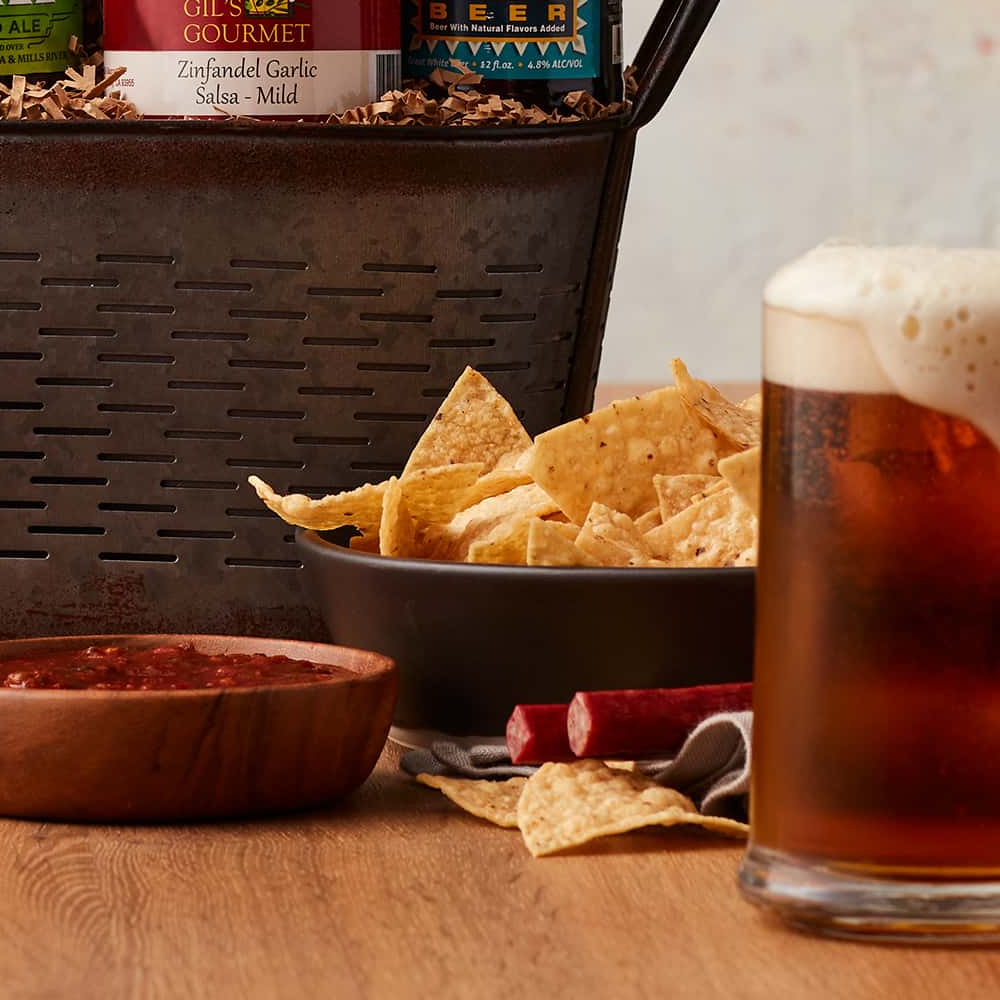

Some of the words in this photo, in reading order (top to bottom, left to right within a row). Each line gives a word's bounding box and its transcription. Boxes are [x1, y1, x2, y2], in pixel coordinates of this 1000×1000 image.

[429, 2, 567, 22] BEER
[8, 18, 41, 34] ALE
[183, 23, 311, 44] GOURMET
[430, 22, 448, 32] Beer
[450, 23, 469, 32] With
[471, 24, 504, 33] Natural
[506, 24, 538, 33] Flavors
[540, 23, 566, 33] Added
[177, 57, 260, 85] Zinfandel
[265, 57, 318, 79] Garlic
[527, 61, 550, 70] 4.8%
[552, 59, 583, 69] ALC/VOL
[196, 84, 240, 105] Salsa
[257, 83, 298, 105] Mild
